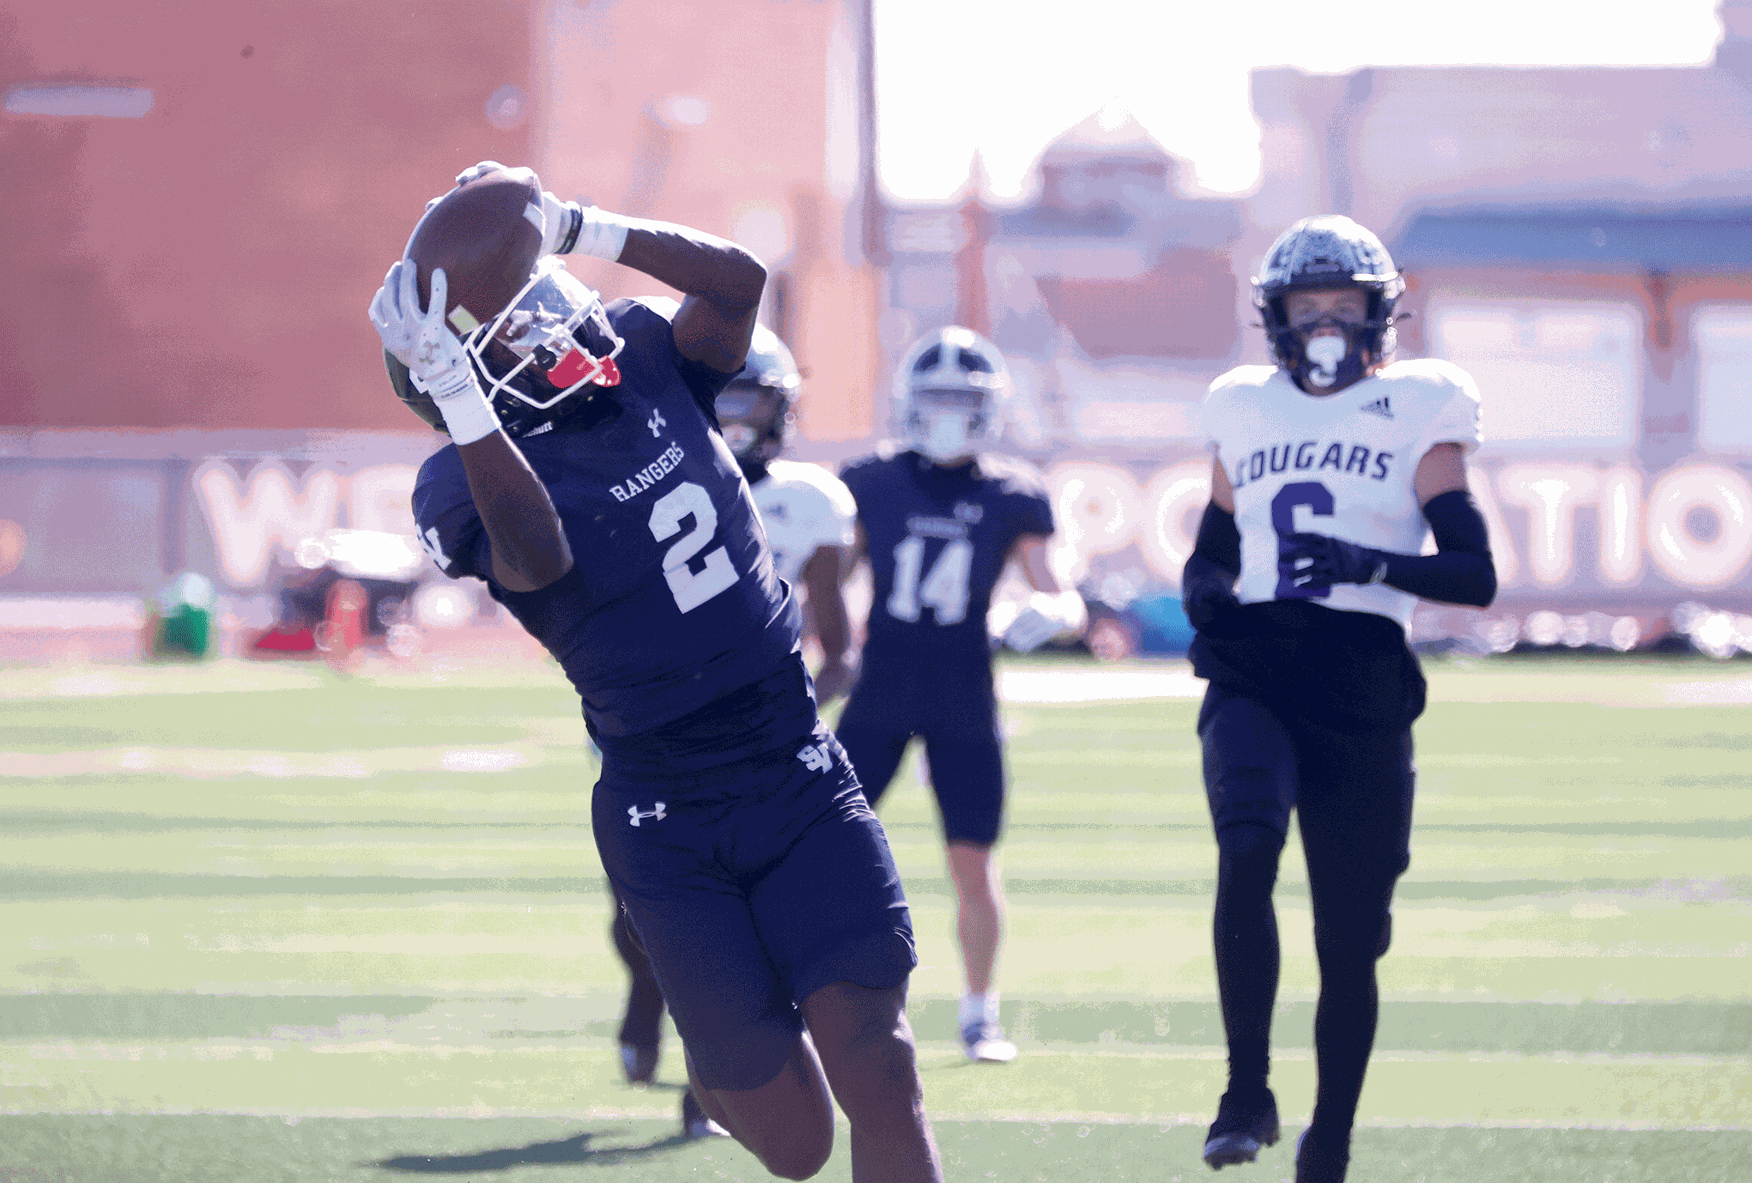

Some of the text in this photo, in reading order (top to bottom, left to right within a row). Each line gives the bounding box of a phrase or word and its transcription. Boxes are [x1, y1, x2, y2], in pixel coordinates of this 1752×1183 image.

[608, 441, 685, 502] RANGERS
[1235, 441, 1394, 487] COUGARS
[647, 481, 741, 615] 2
[886, 533, 974, 626] 14
[1271, 481, 1334, 598] 6
